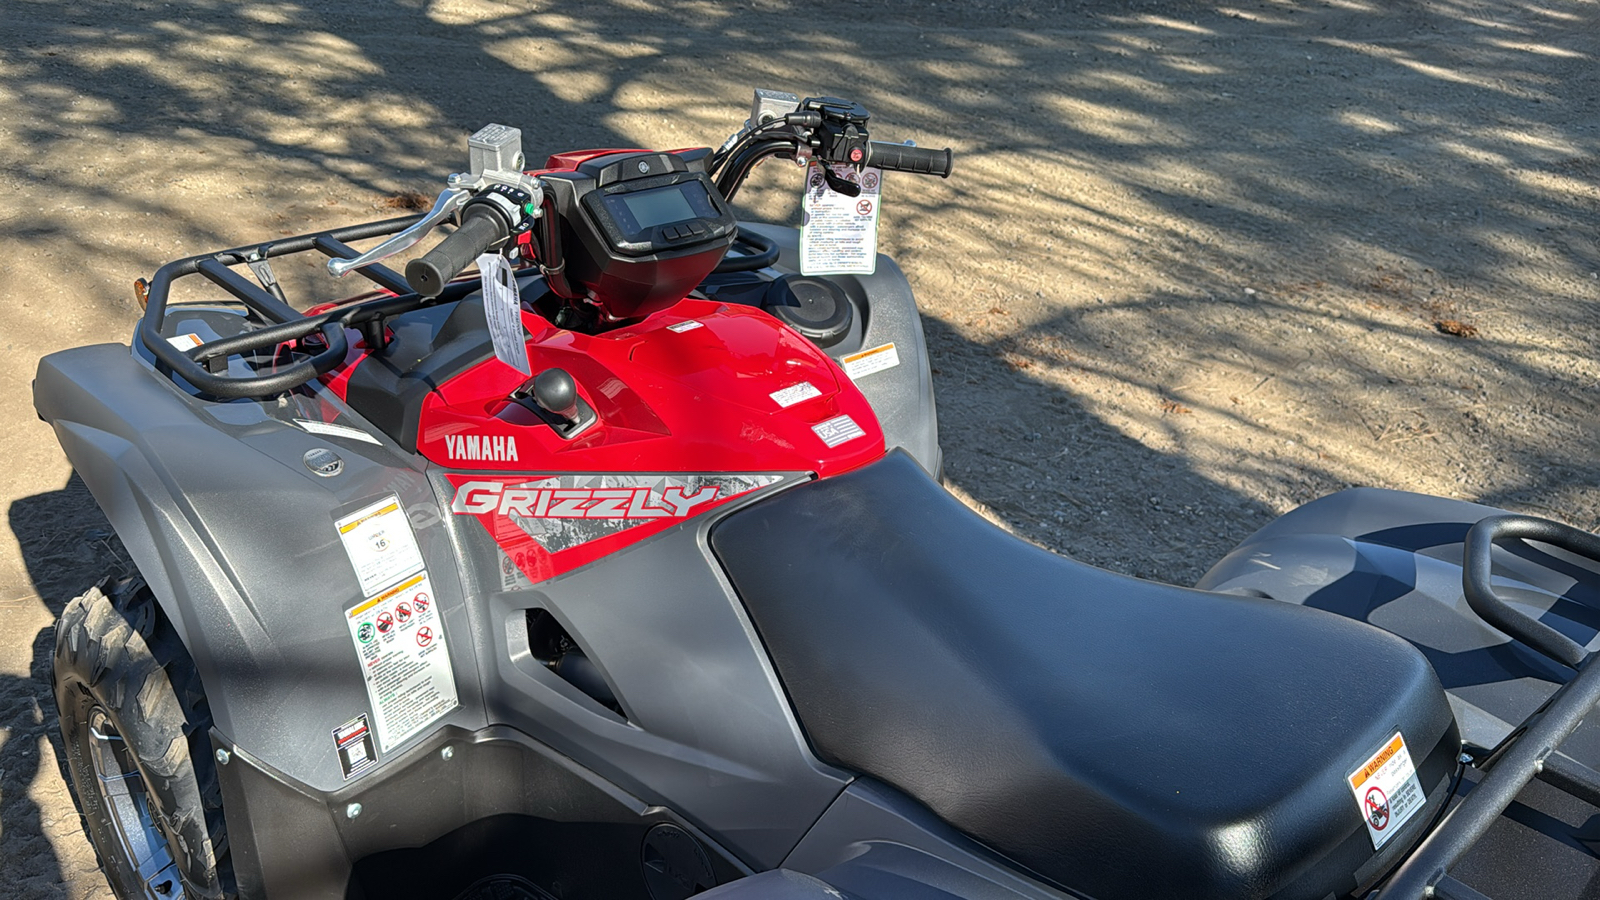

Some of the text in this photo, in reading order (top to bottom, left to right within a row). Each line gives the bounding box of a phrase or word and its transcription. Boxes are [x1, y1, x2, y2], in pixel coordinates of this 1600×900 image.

[814, 424, 840, 440] USA
[445, 435, 518, 462] YAMAHA
[452, 481, 720, 518] GRIZZLY
[376, 539, 386, 549] 16
[1370, 746, 1393, 772] WARNING
